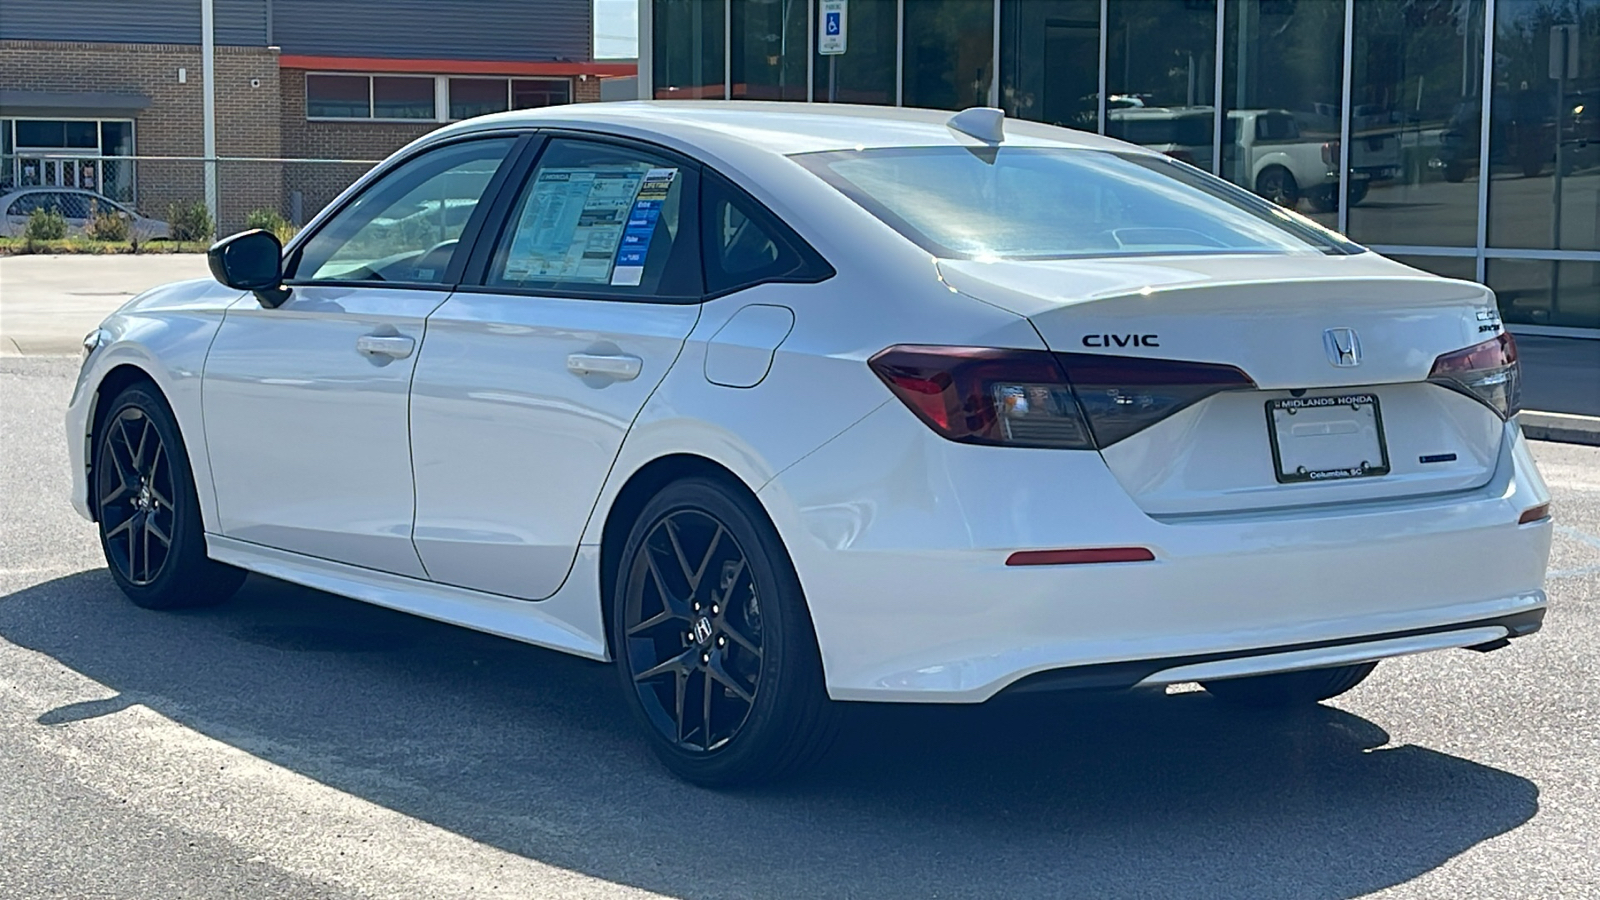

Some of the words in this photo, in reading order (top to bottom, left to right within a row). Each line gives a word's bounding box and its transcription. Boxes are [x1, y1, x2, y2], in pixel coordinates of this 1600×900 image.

[1082, 334, 1160, 347] CIVIC
[1282, 398, 1335, 408] MIDLANDS
[1338, 396, 1373, 404] HONDA
[1310, 470, 1350, 479] Columbia,
[1350, 468, 1363, 476] SC
